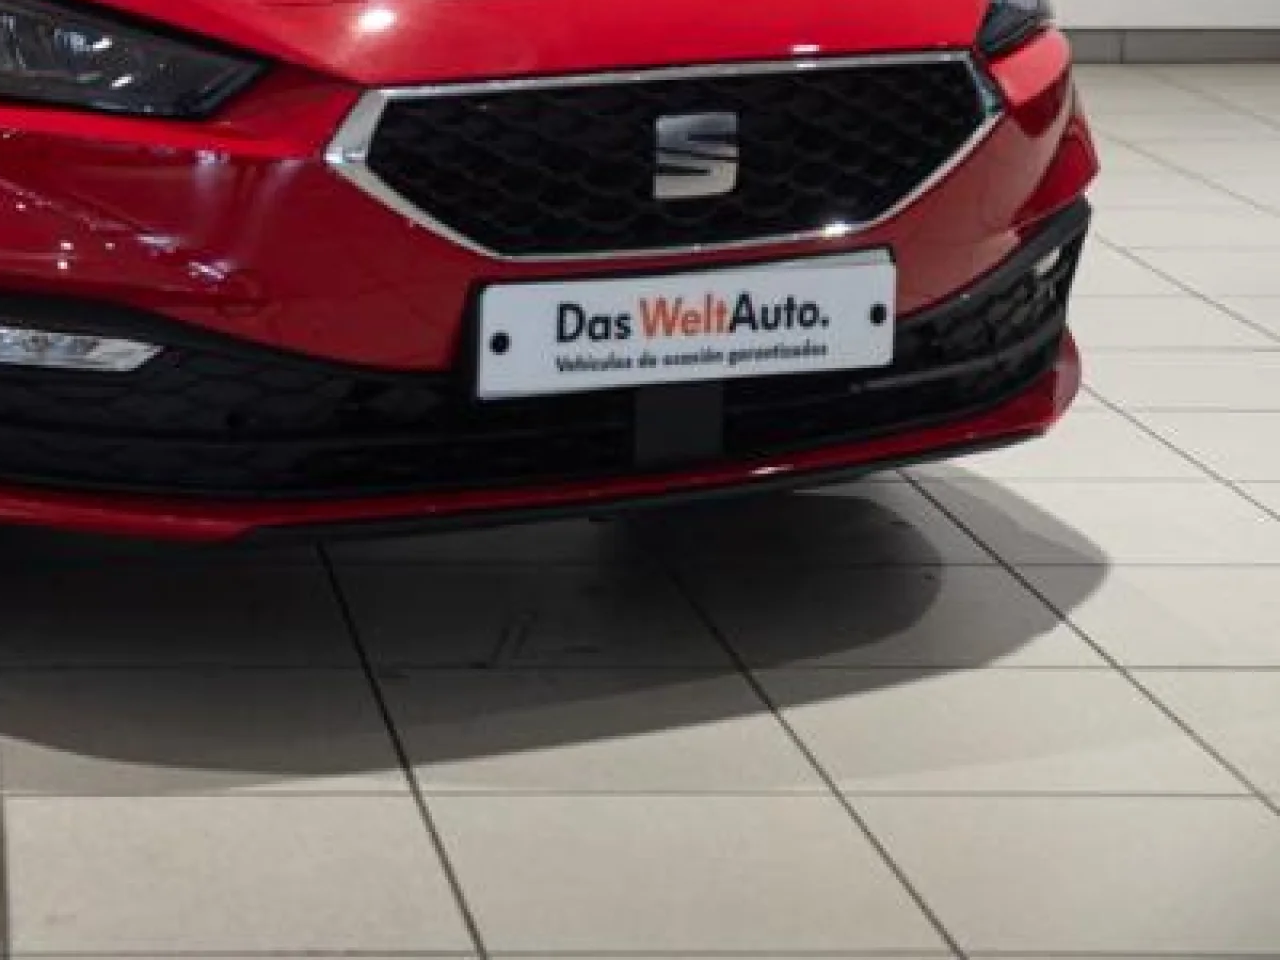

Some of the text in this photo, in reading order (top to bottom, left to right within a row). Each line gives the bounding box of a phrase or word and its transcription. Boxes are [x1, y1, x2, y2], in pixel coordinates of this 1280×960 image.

[556, 291, 830, 342] Das WeltAuto.
[638, 350, 657, 368] de
